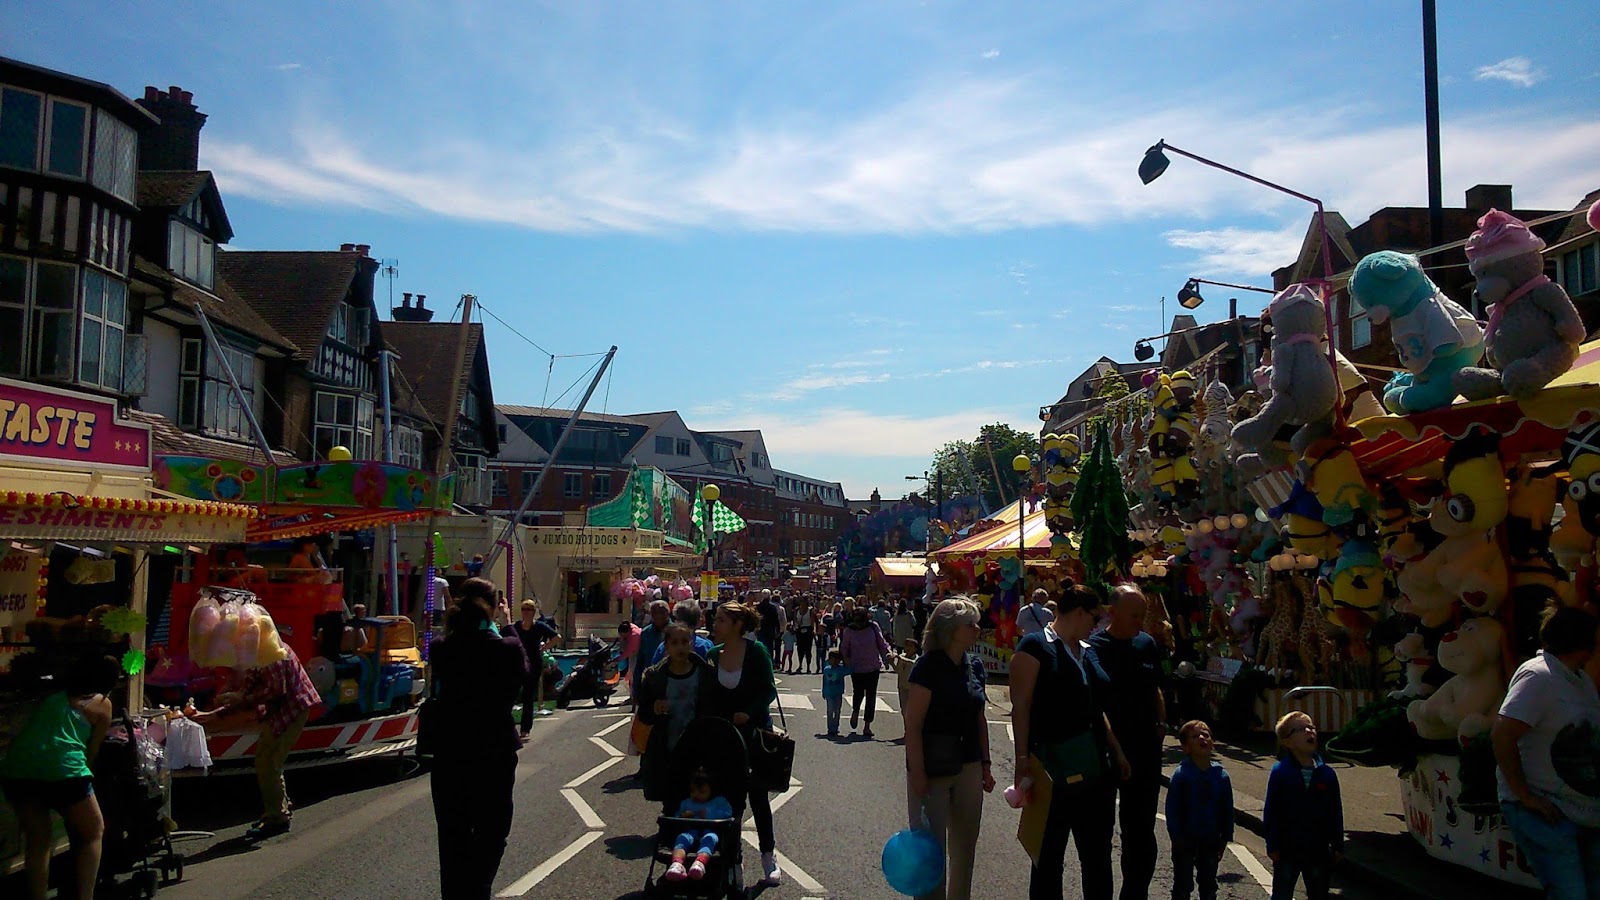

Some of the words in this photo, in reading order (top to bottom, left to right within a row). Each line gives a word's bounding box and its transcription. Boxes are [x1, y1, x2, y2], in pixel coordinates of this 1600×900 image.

[0, 399, 96, 449] TASTE
[0, 506, 167, 530] ESHMENTS
[543, 534, 574, 545] JUMBO
[575, 534, 593, 545] HOT
[594, 534, 619, 545] DOGS
